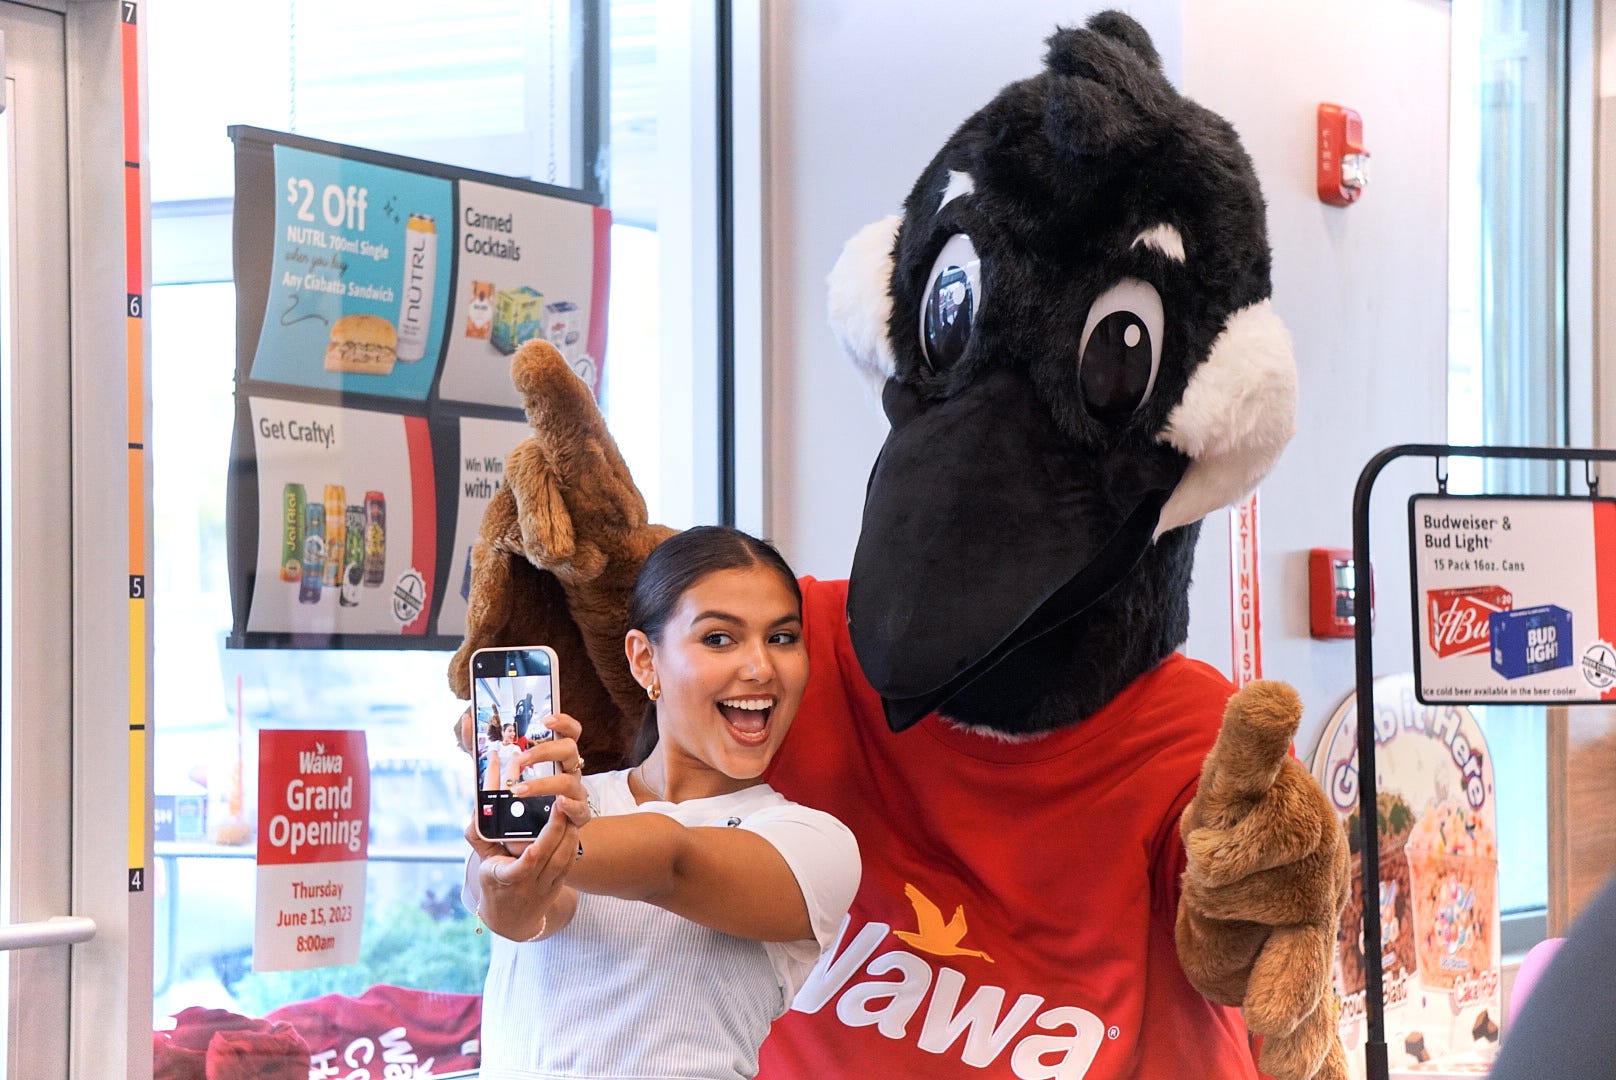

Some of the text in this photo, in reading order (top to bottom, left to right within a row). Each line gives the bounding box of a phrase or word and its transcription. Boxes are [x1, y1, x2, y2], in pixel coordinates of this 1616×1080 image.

[124, 2, 134, 22] 7
[287, 176, 368, 231] $2 Off
[464, 207, 513, 234] Canned
[287, 225, 327, 248] NUTRL
[360, 240, 389, 261] Single
[464, 233, 521, 261] Cocktails
[282, 271, 394, 303] Any Ciabatta Sandwich
[130, 296, 140, 317] 6
[260, 417, 336, 449] Get Crafty!
[465, 456, 503, 473] Win Win
[465, 477, 491, 499] with
[1424, 514, 1512, 531] Budweiser &
[1425, 533, 1490, 552] Bud Light
[1434, 559, 1525, 572] 15 Pack 16oz. Cans
[132, 577, 142, 598] 5
[1240, 506, 1251, 683] XTINGUIS
[1527, 626, 1556, 646] BUD
[1526, 644, 1558, 664] LIGHT
[1436, 686, 1451, 696] cold
[1454, 686, 1471, 696] beer
[1474, 686, 1508, 696] available
[1510, 686, 1517, 696] in
[1519, 686, 1531, 696] the
[1534, 686, 1551, 696] beer
[1553, 686, 1577, 696] cooler
[299, 750, 343, 775] Wawa
[286, 776, 353, 811] Grand
[268, 811, 362, 855] Opening
[131, 870, 141, 890] 4
[291, 879, 344, 900] Thursday
[276, 906, 352, 927] June 15, 2023
[296, 935, 335, 952] 8:00am
